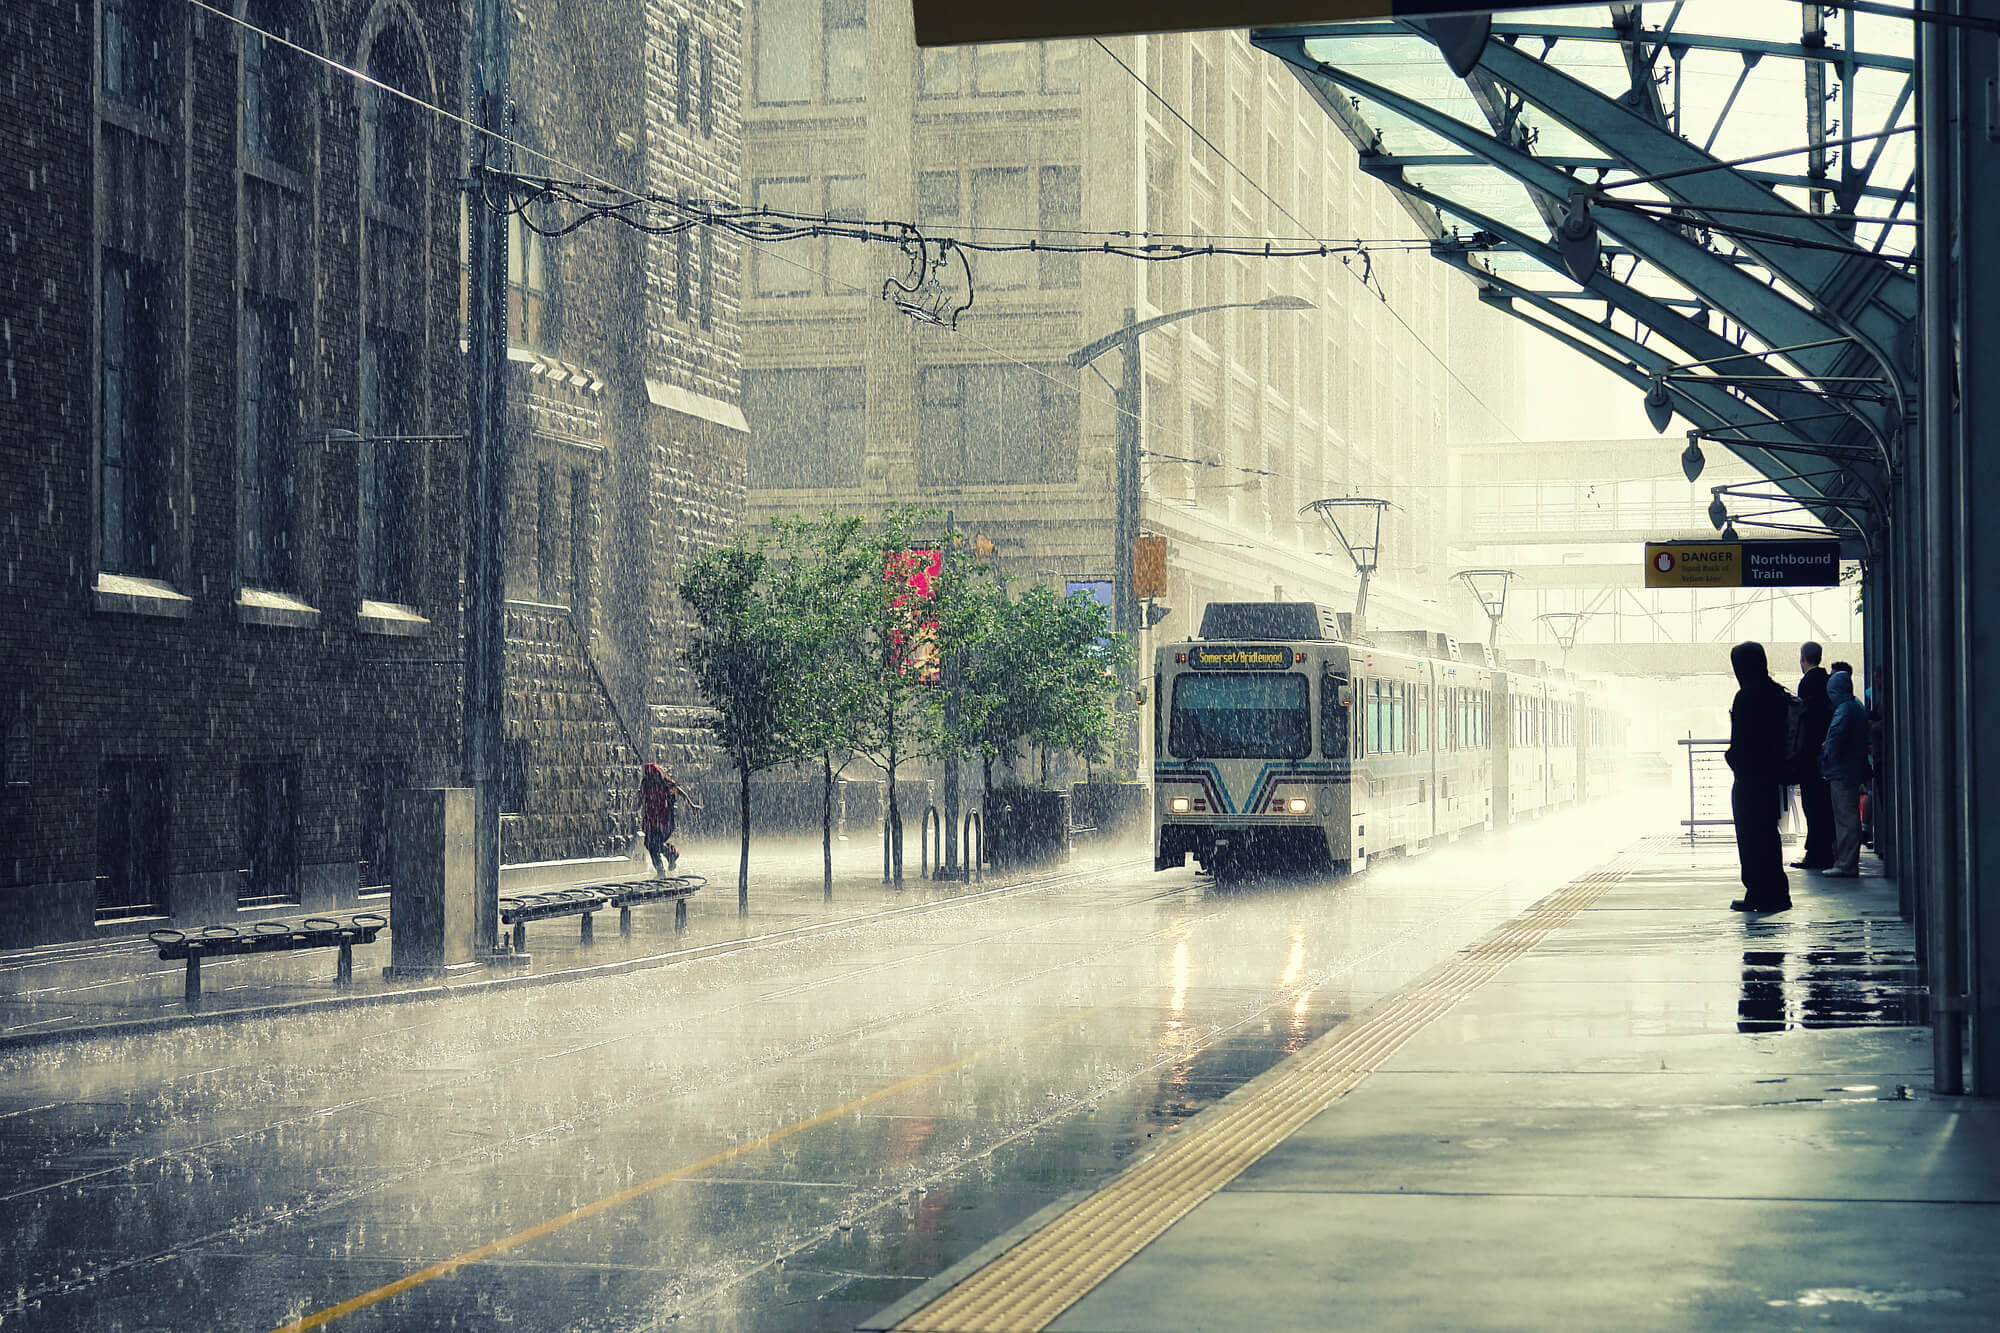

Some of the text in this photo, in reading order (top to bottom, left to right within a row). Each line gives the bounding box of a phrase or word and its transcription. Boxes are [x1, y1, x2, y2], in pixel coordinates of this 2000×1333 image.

[1681, 552, 1733, 562] DANGER
[1751, 553, 1831, 565] Northbound
[1751, 569, 1784, 579] Train
[1199, 651, 1283, 663] Somerset/Bridlewood
